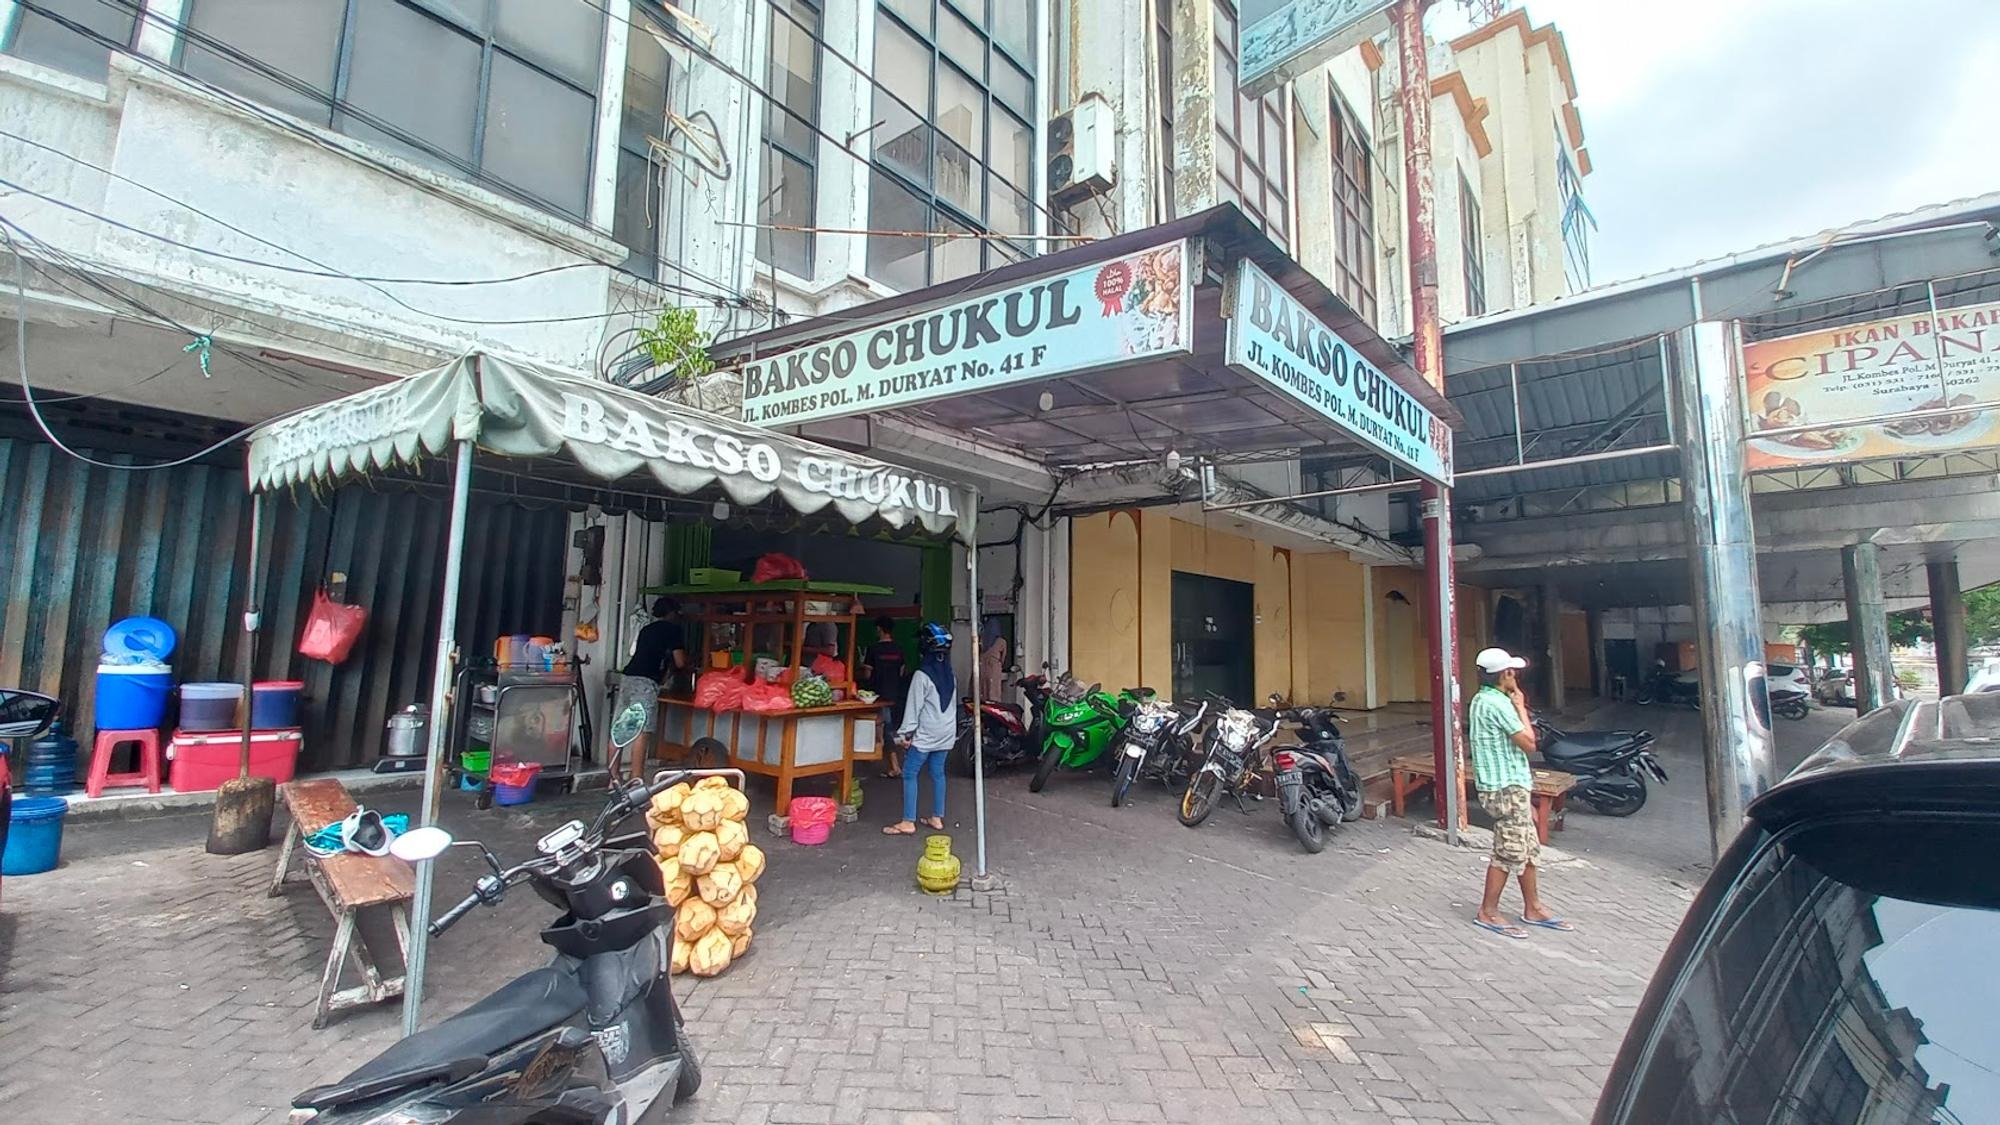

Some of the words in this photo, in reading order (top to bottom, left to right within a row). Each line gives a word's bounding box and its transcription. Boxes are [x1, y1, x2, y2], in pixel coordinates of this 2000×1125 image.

[1102, 285, 1122, 296] HALAL
[1103, 276, 1124, 288] 100%
[745, 340, 857, 400] BAKSO
[866, 279, 1081, 370] CHUKUL
[1250, 273, 1348, 387] BAKSO
[1353, 360, 1426, 444] CHUKUL
[1765, 329, 2000, 381] CIPAN
[1833, 324, 1899, 348] IKAN
[743, 408, 759, 423] JL.
[762, 395, 817, 420] KOMBES
[820, 388, 853, 409] POL.
[857, 383, 875, 401] M.
[879, 365, 957, 397] DURYAT
[961, 360, 995, 381] No.
[1000, 353, 1024, 374] 41
[1031, 345, 1047, 367] F
[1247, 340, 1269, 371] JL.
[1271, 354, 1322, 403] KOMBES
[1323, 389, 1346, 419] POL.
[1348, 405, 1358, 427] M.
[1359, 416, 1393, 447] DURYAT
[1872, 383, 1930, 396] Surabaya
[561, 391, 782, 483] BAKSO
[797, 456, 960, 519] CHUKUL
